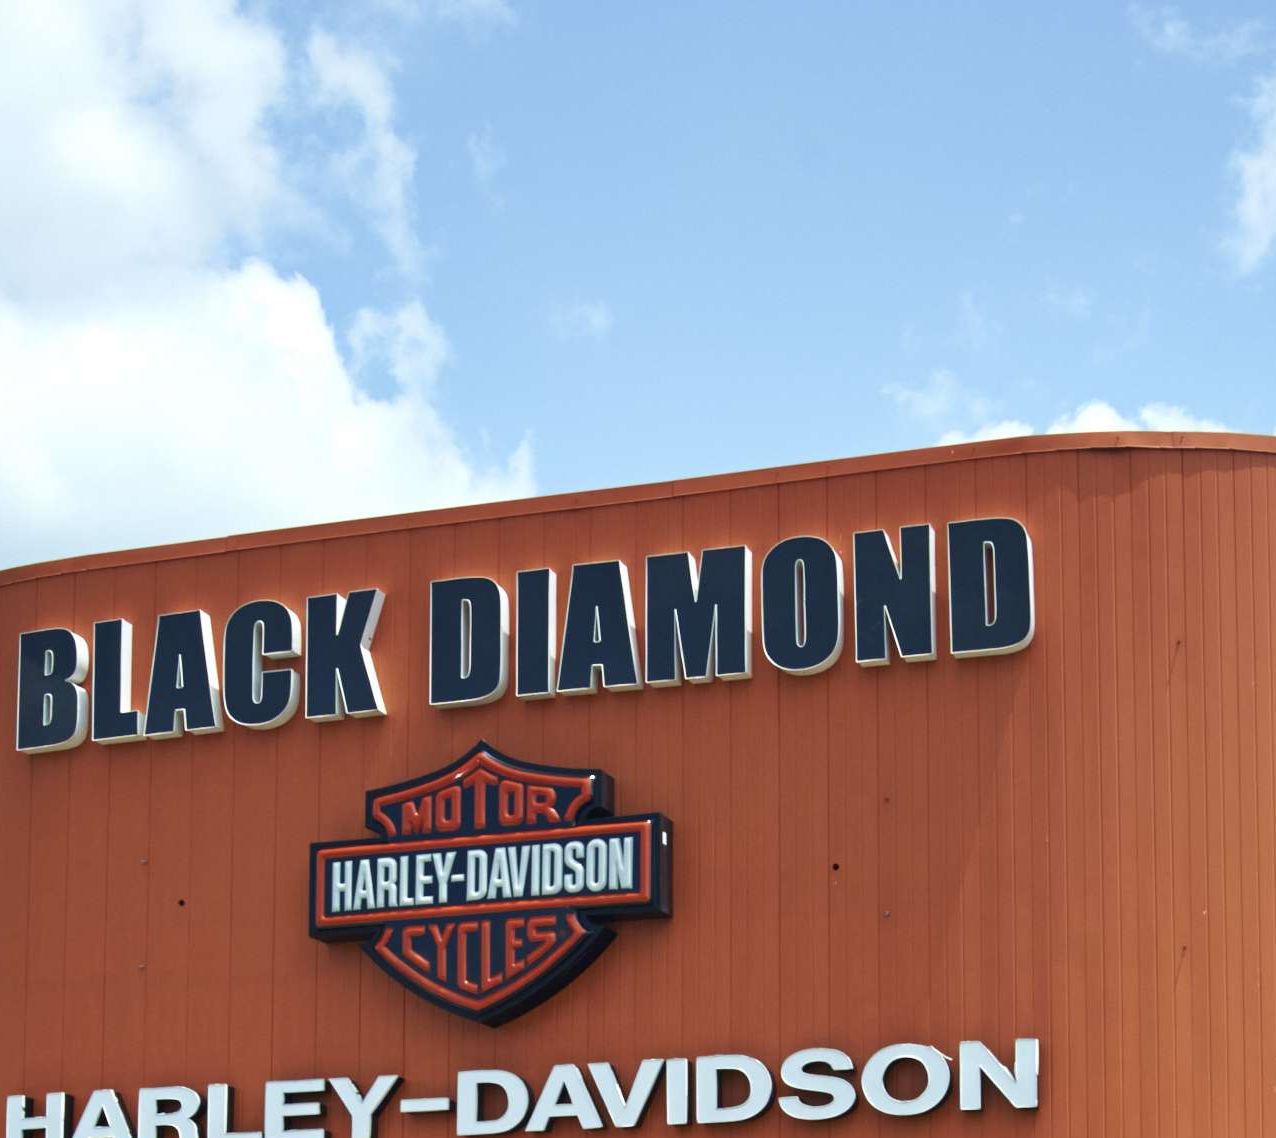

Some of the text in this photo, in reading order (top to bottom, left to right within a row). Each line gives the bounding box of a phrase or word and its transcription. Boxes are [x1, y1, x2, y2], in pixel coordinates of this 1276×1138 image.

[15, 517, 1035, 754] BLACK DIAMOND
[401, 767, 561, 835] MOTOR
[331, 836, 634, 913] HARLEY-DAVIDSON
[403, 915, 556, 993] CYCLES
